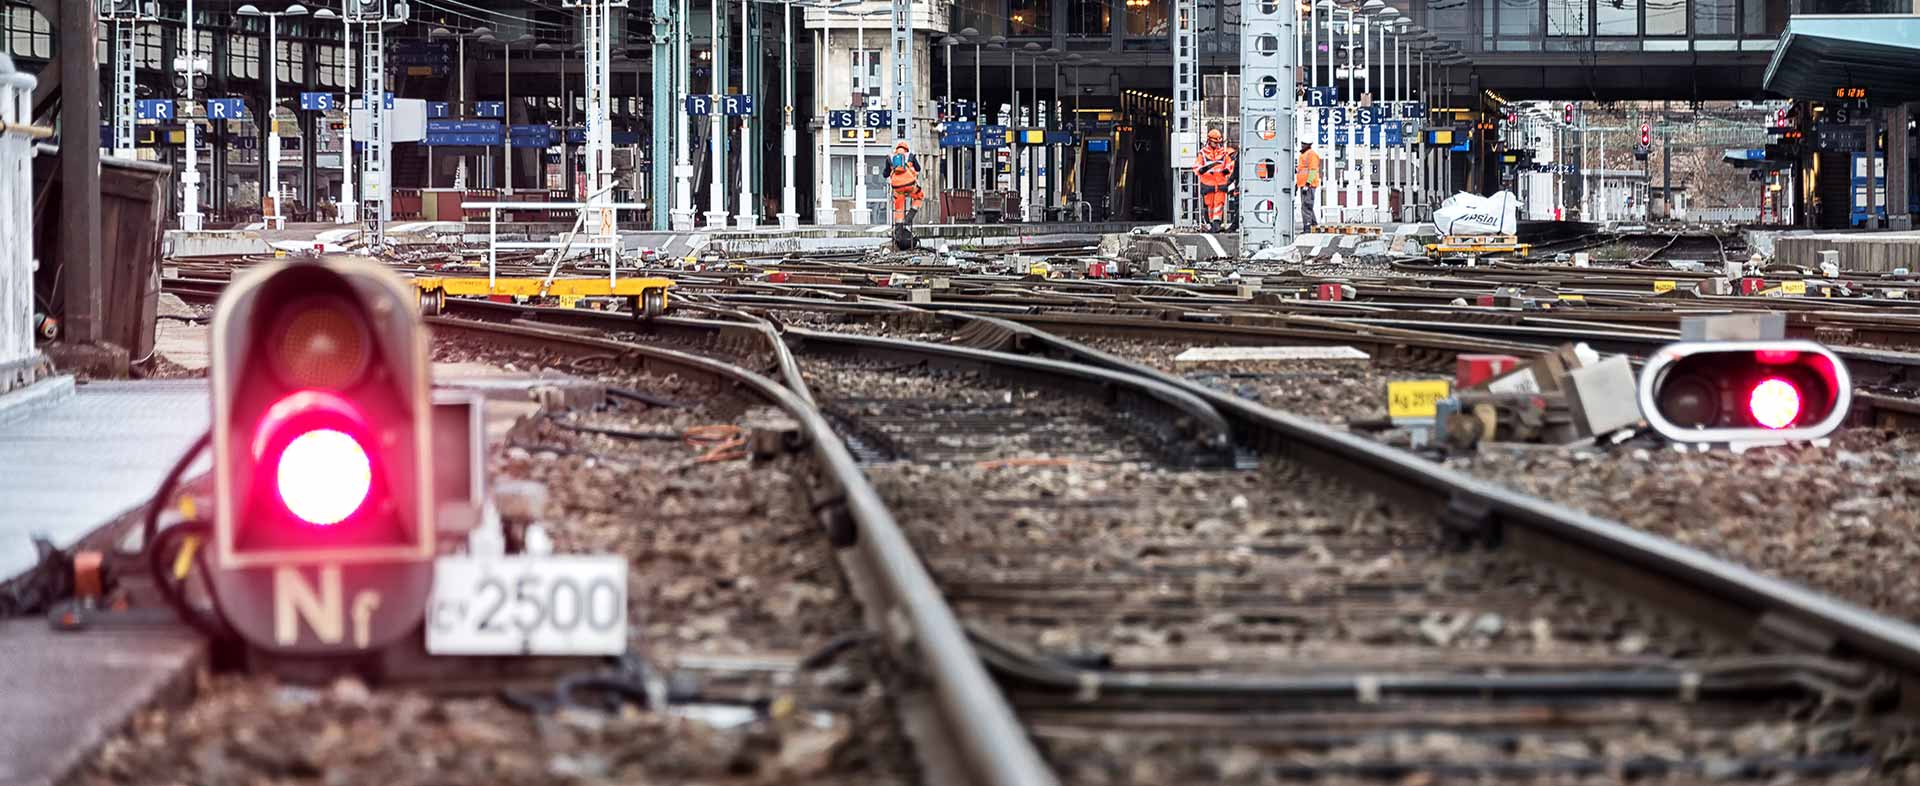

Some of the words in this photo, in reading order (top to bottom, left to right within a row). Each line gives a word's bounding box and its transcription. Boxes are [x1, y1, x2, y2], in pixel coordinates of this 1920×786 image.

[318, 95, 328, 109] S
[1311, 91, 1323, 106] R
[156, 103, 168, 118] R
[214, 103, 226, 118] R
[435, 105, 444, 117] T
[491, 104, 500, 117] T
[695, 99, 706, 114] R
[726, 99, 738, 114] R
[956, 105, 967, 116] T
[1404, 105, 1414, 117] T
[842, 113, 852, 126] S
[869, 113, 880, 126] S
[1333, 110, 1342, 124] S
[1361, 110, 1371, 124] S
[1836, 110, 1847, 123] S
[476, 574, 623, 633] 2500
